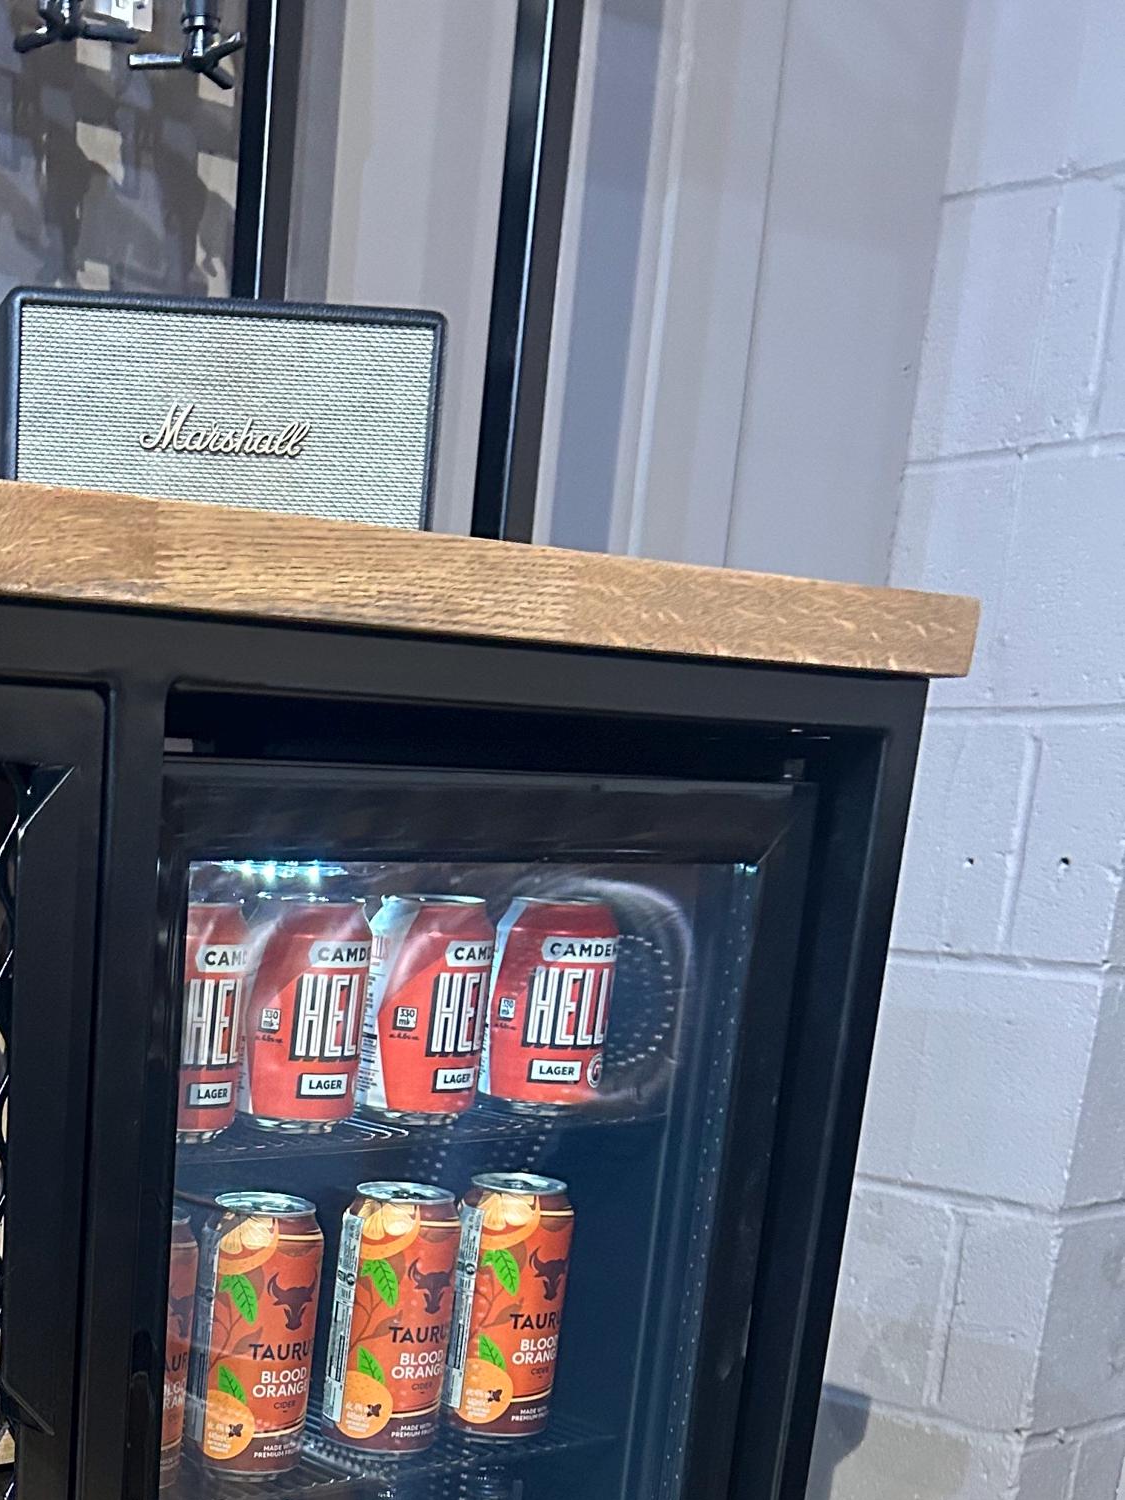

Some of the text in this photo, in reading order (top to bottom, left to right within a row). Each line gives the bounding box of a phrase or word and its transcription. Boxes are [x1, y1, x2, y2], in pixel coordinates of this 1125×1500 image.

[139, 401, 311, 457] Marshall
[400, 1009, 415, 1018] 330
[539, 1065, 575, 1076] LAGER
[309, 1080, 343, 1090] LAGER
[197, 1088, 228, 1099] LAGER
[400, 1350, 444, 1365] BLOOD
[261, 1367, 307, 1383] BLOOD
[391, 1430, 420, 1438] PREMIUM
[254, 1451, 283, 1459] PREMIUM
